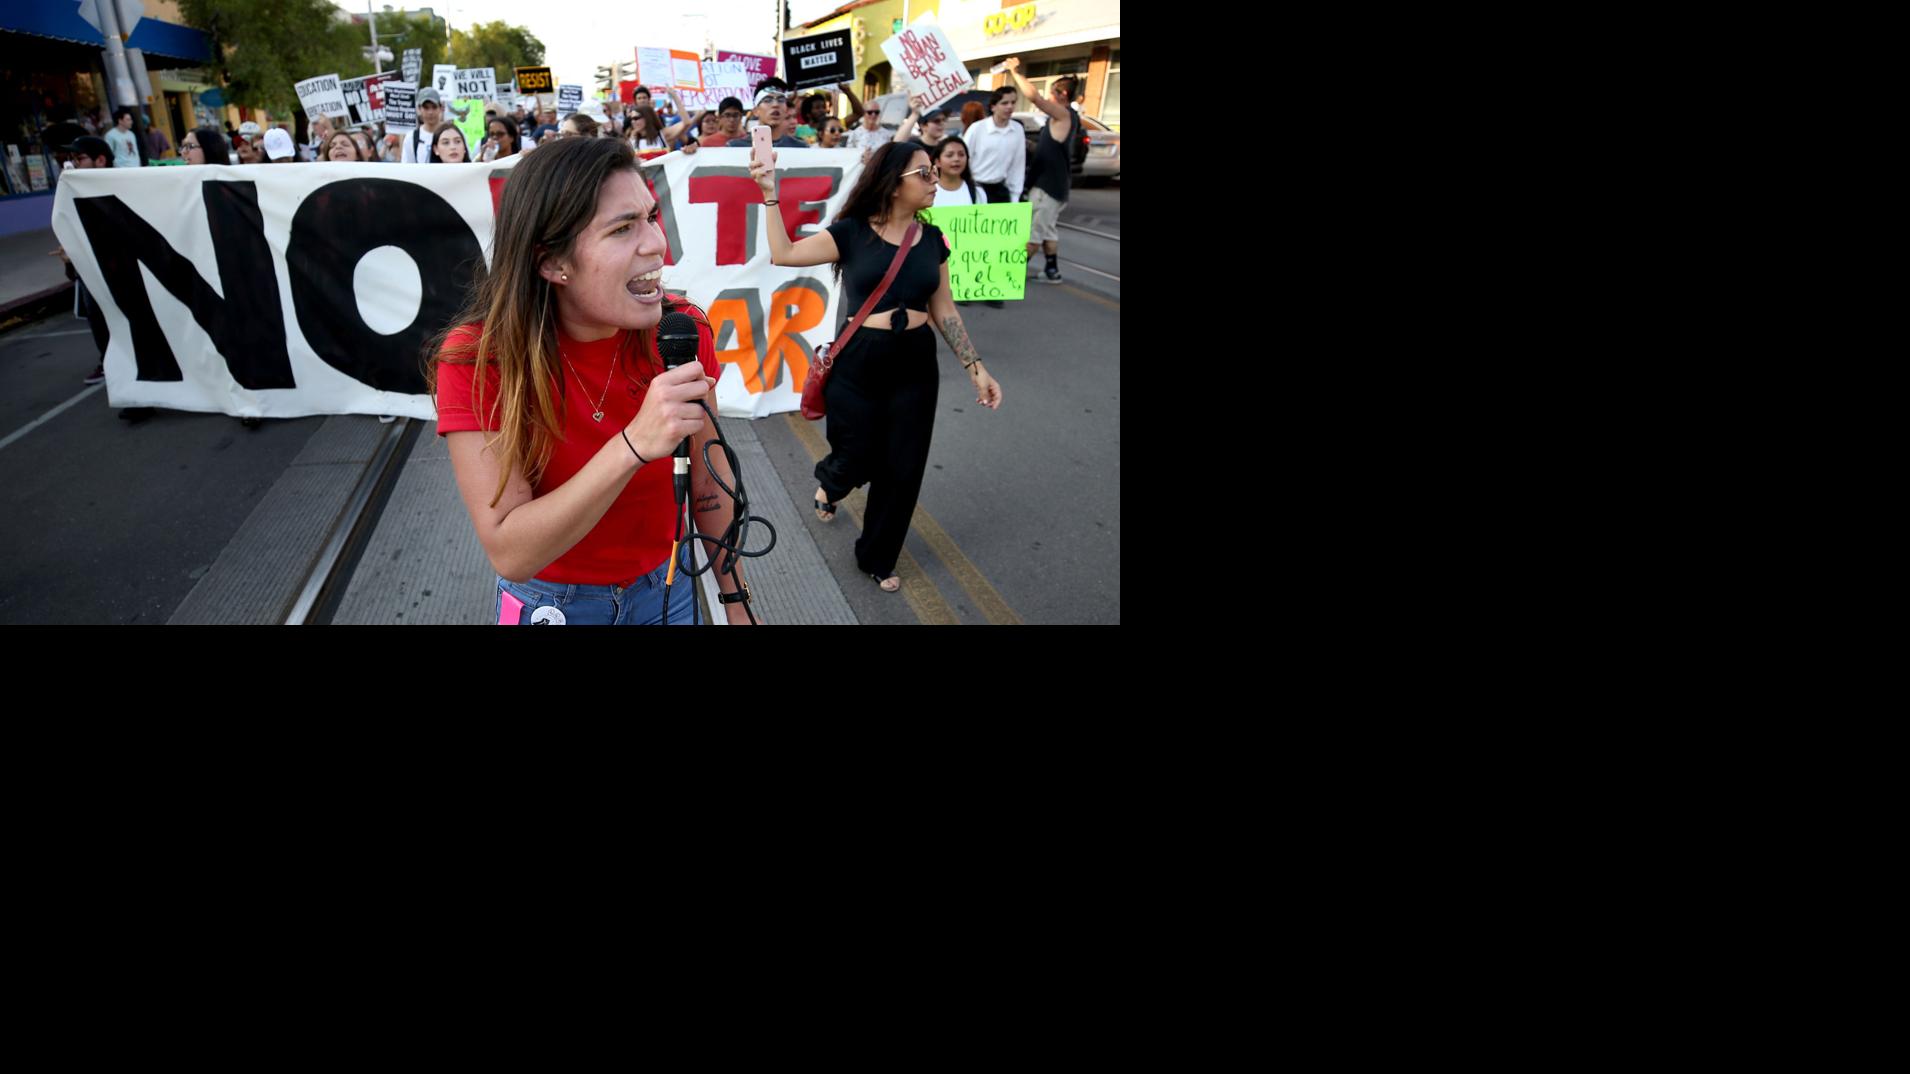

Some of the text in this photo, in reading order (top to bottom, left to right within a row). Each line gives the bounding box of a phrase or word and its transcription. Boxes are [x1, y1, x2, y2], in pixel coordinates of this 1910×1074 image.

[789, 37, 844, 56] BLACK LIVES
[898, 30, 917, 49] NO
[701, 62, 743, 74] ATION
[803, 53, 835, 67] MATTER
[907, 48, 947, 79] BEING
[453, 69, 492, 80] WE WILL
[519, 71, 551, 89] RESIST
[703, 73, 720, 87] OT
[921, 66, 942, 86] IS
[457, 80, 488, 94] NOT
[918, 71, 969, 109] ILLEGAL
[949, 209, 1018, 250] quitaron
[961, 248, 1028, 273] que nos
[974, 265, 996, 284] el
[73, 177, 491, 395] NO
[957, 284, 1005, 299] iedo.
